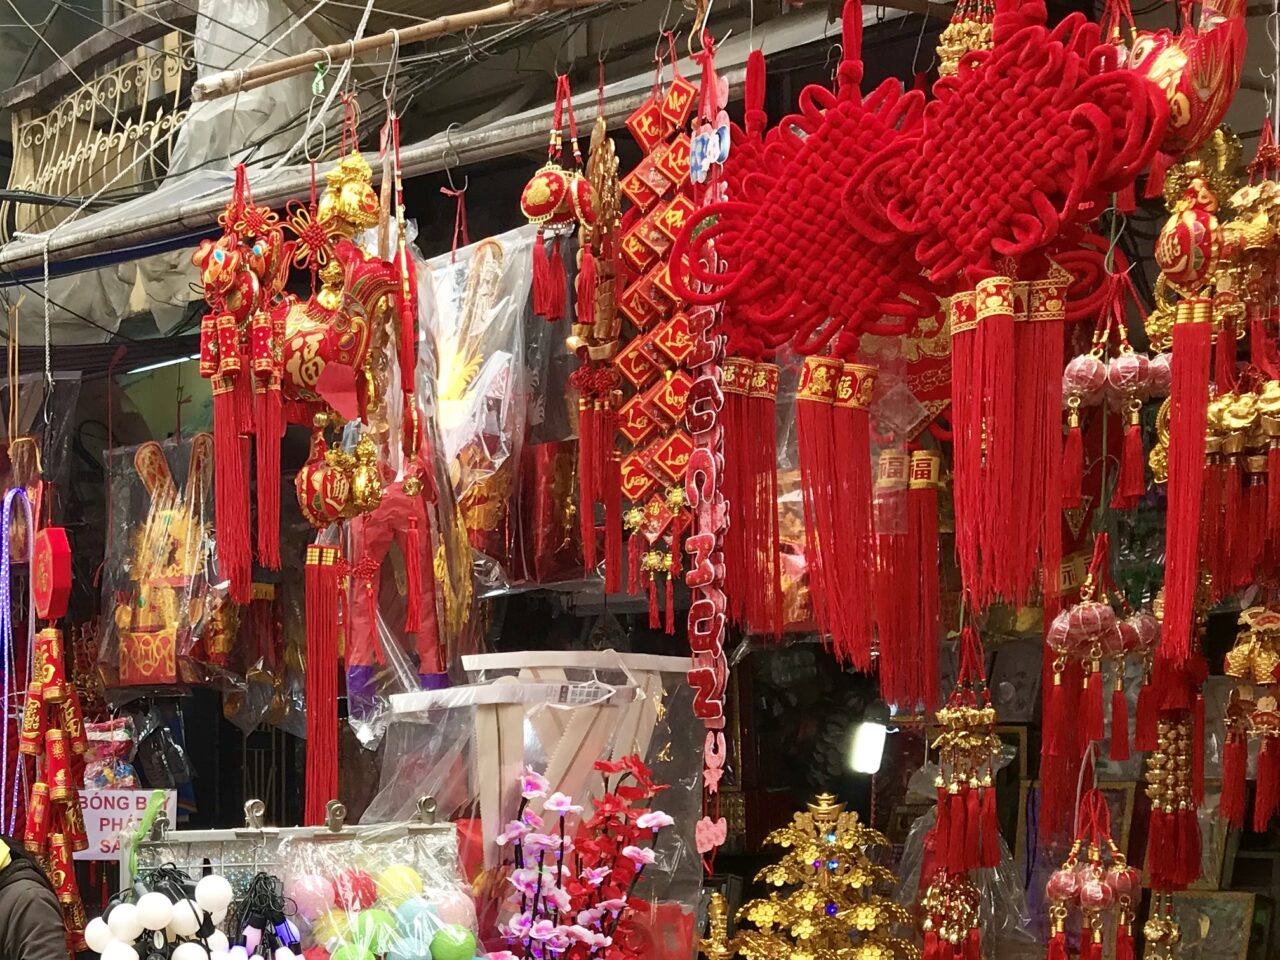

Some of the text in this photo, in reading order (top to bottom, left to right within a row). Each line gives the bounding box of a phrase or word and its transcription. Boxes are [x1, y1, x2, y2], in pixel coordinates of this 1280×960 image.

[286, 333, 326, 388] 福
[880, 457, 904, 478] 福
[911, 458, 932, 480] 福
[80, 791, 170, 810] BÓNG BY
[99, 814, 143, 832] PHÁ
